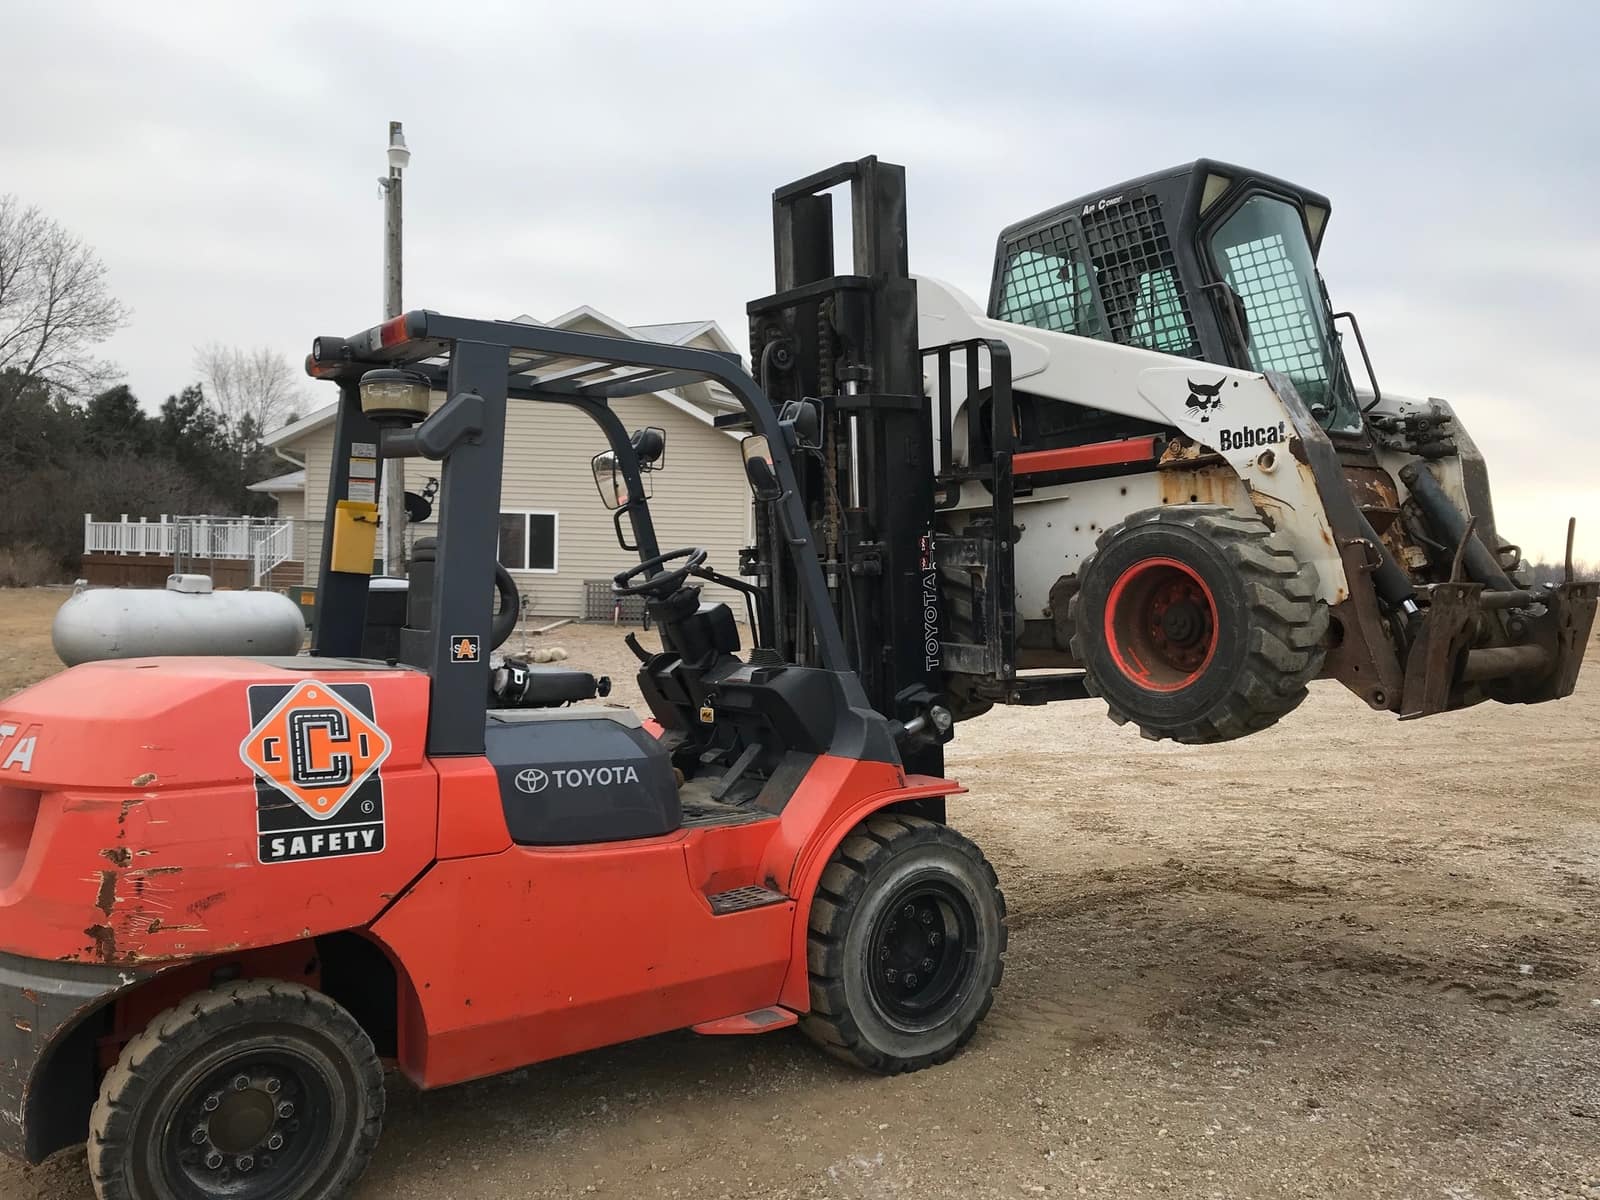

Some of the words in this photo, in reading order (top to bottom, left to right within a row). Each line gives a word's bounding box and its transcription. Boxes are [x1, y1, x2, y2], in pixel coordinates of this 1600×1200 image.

[1219, 421, 1286, 451] Bobcat
[923, 572, 940, 672] TOYOTA
[552, 766, 640, 789] TOYOTA
[271, 829, 376, 858] SAFETY
